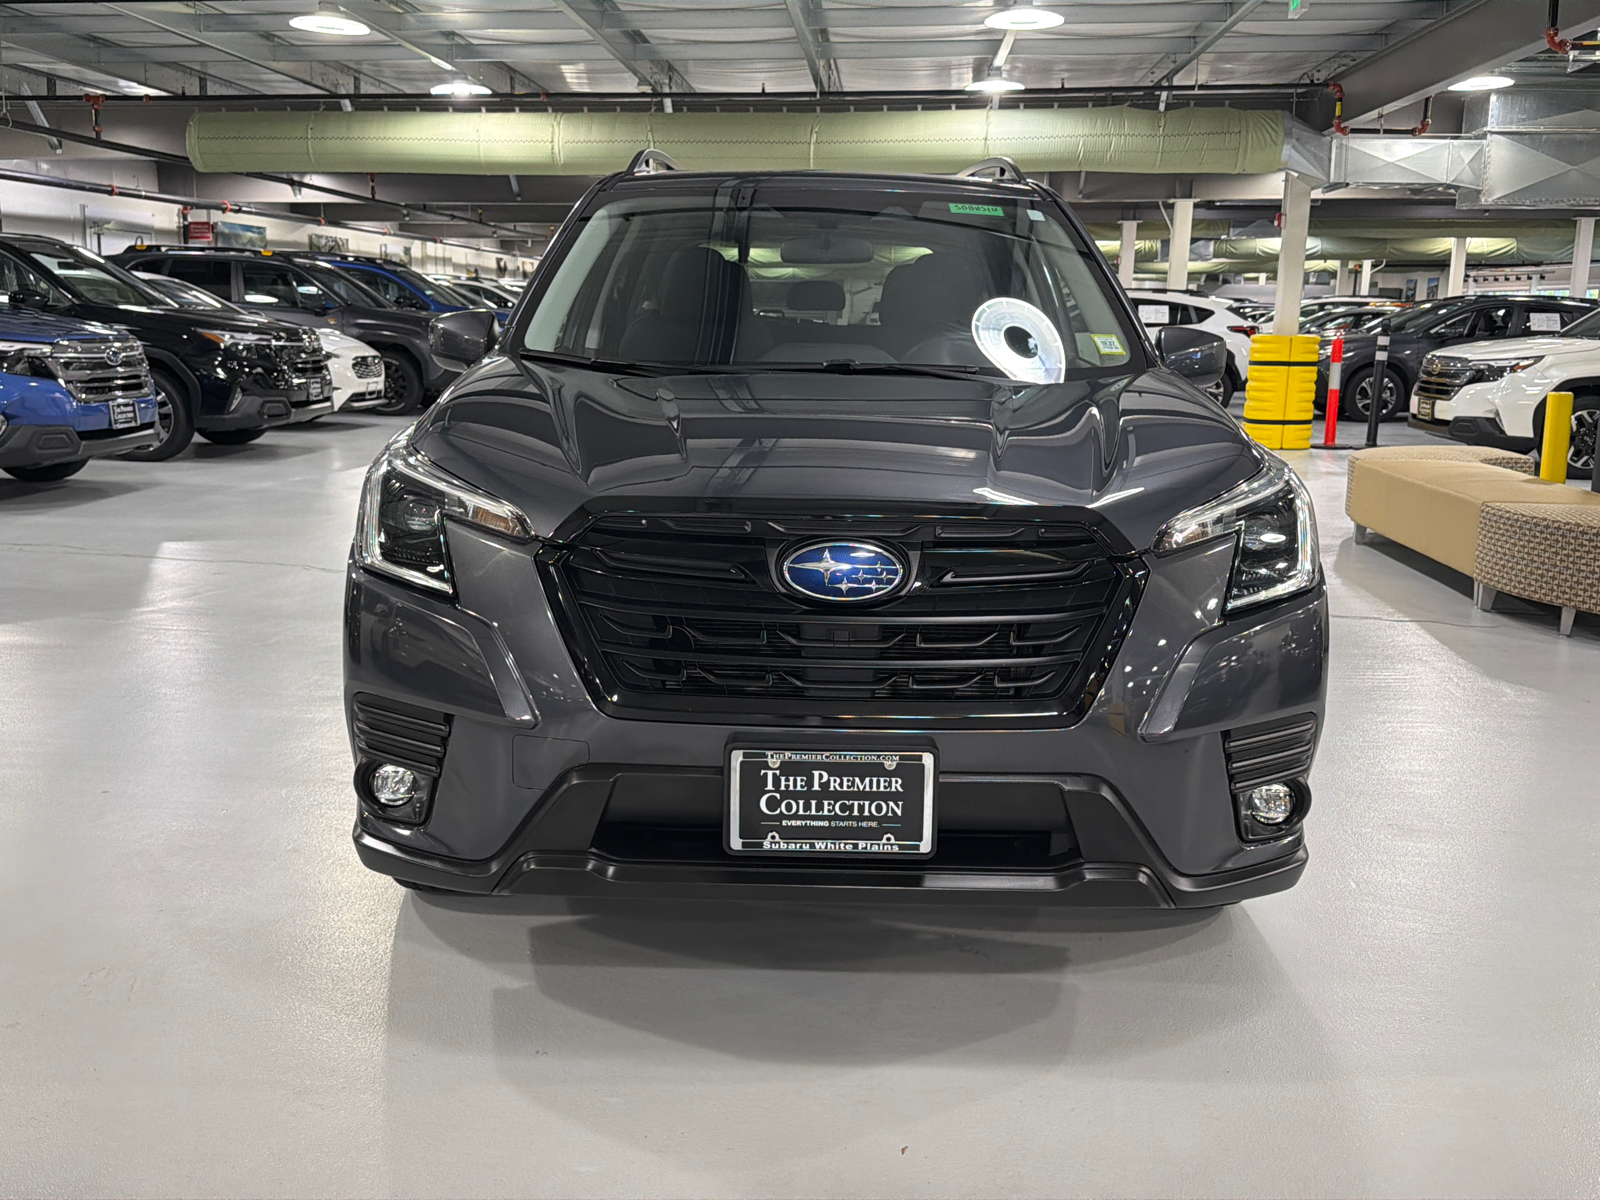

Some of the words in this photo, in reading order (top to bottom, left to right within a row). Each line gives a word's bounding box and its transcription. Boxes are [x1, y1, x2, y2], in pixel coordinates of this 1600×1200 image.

[760, 769, 807, 791] THE
[811, 770, 904, 792] PREMIER
[759, 792, 904, 817] COLLECTION
[781, 819, 829, 827] EVERYTHING
[830, 820, 857, 828] STARTS
[763, 841, 810, 849] Subaru
[814, 841, 853, 850] White
[858, 842, 899, 851] Plains
